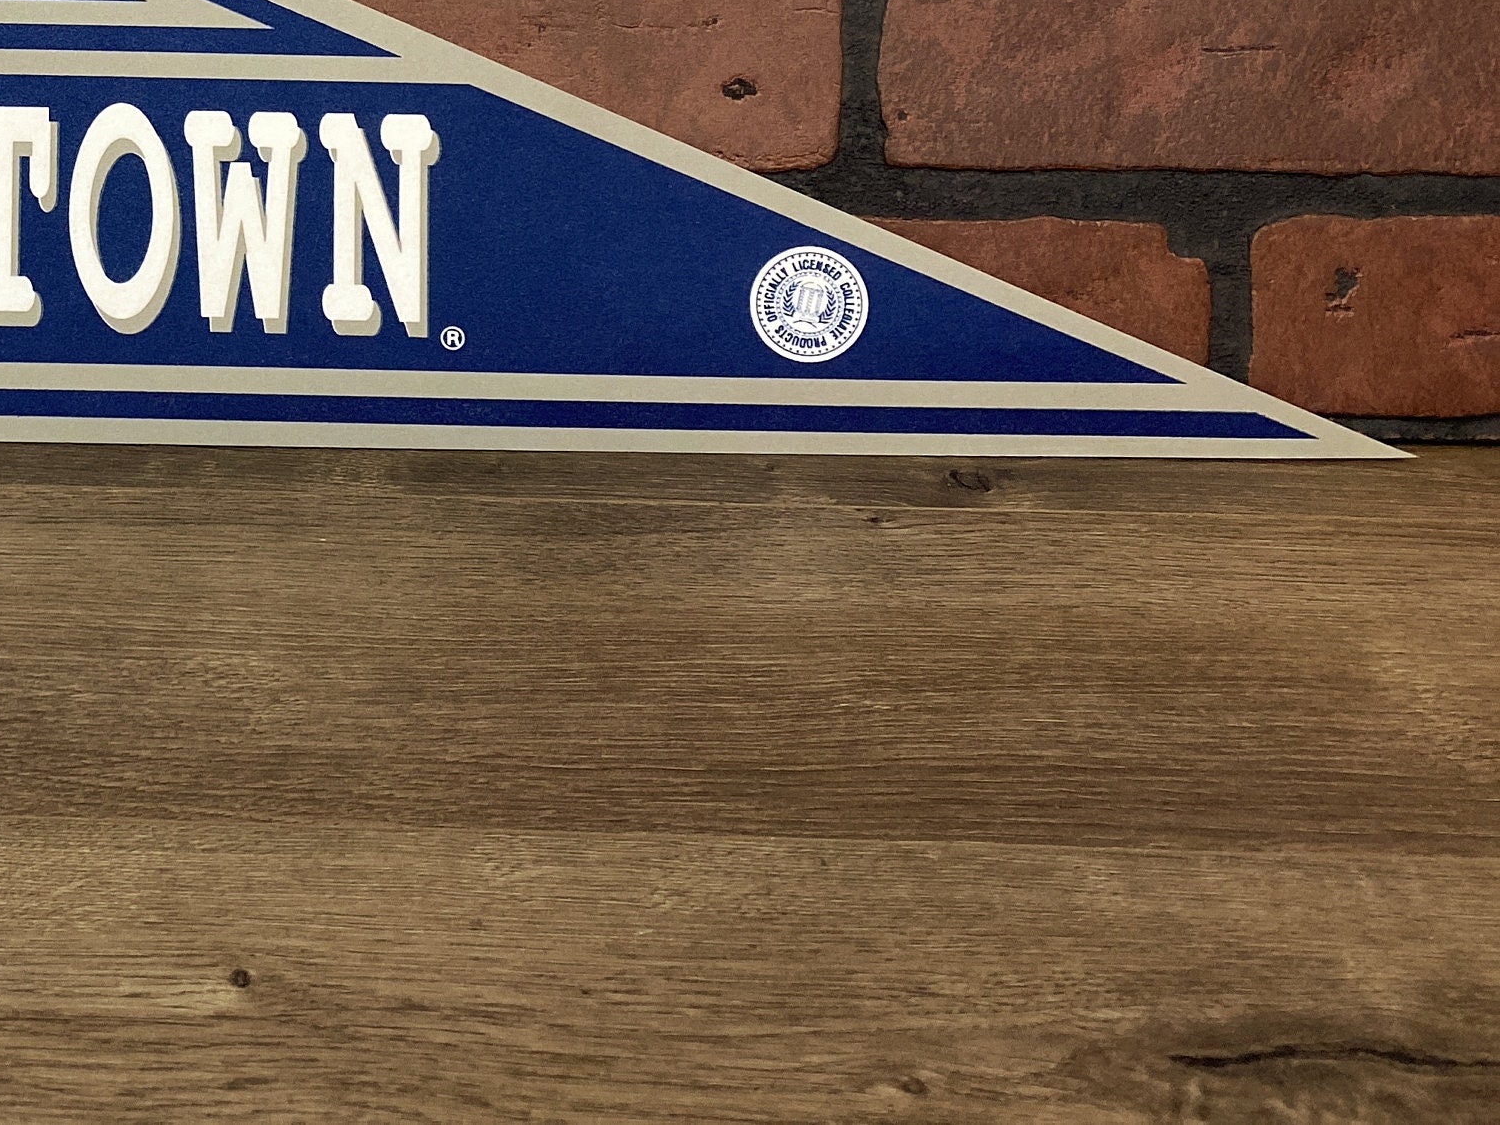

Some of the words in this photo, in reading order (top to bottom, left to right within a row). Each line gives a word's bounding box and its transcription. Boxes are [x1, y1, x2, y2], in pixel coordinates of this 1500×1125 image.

[791, 259, 842, 281] LICENSED
[763, 267, 789, 323] OFFICIALLY
[829, 282, 855, 340] COLLEGIATE
[774, 325, 827, 349] PRODUCTS
